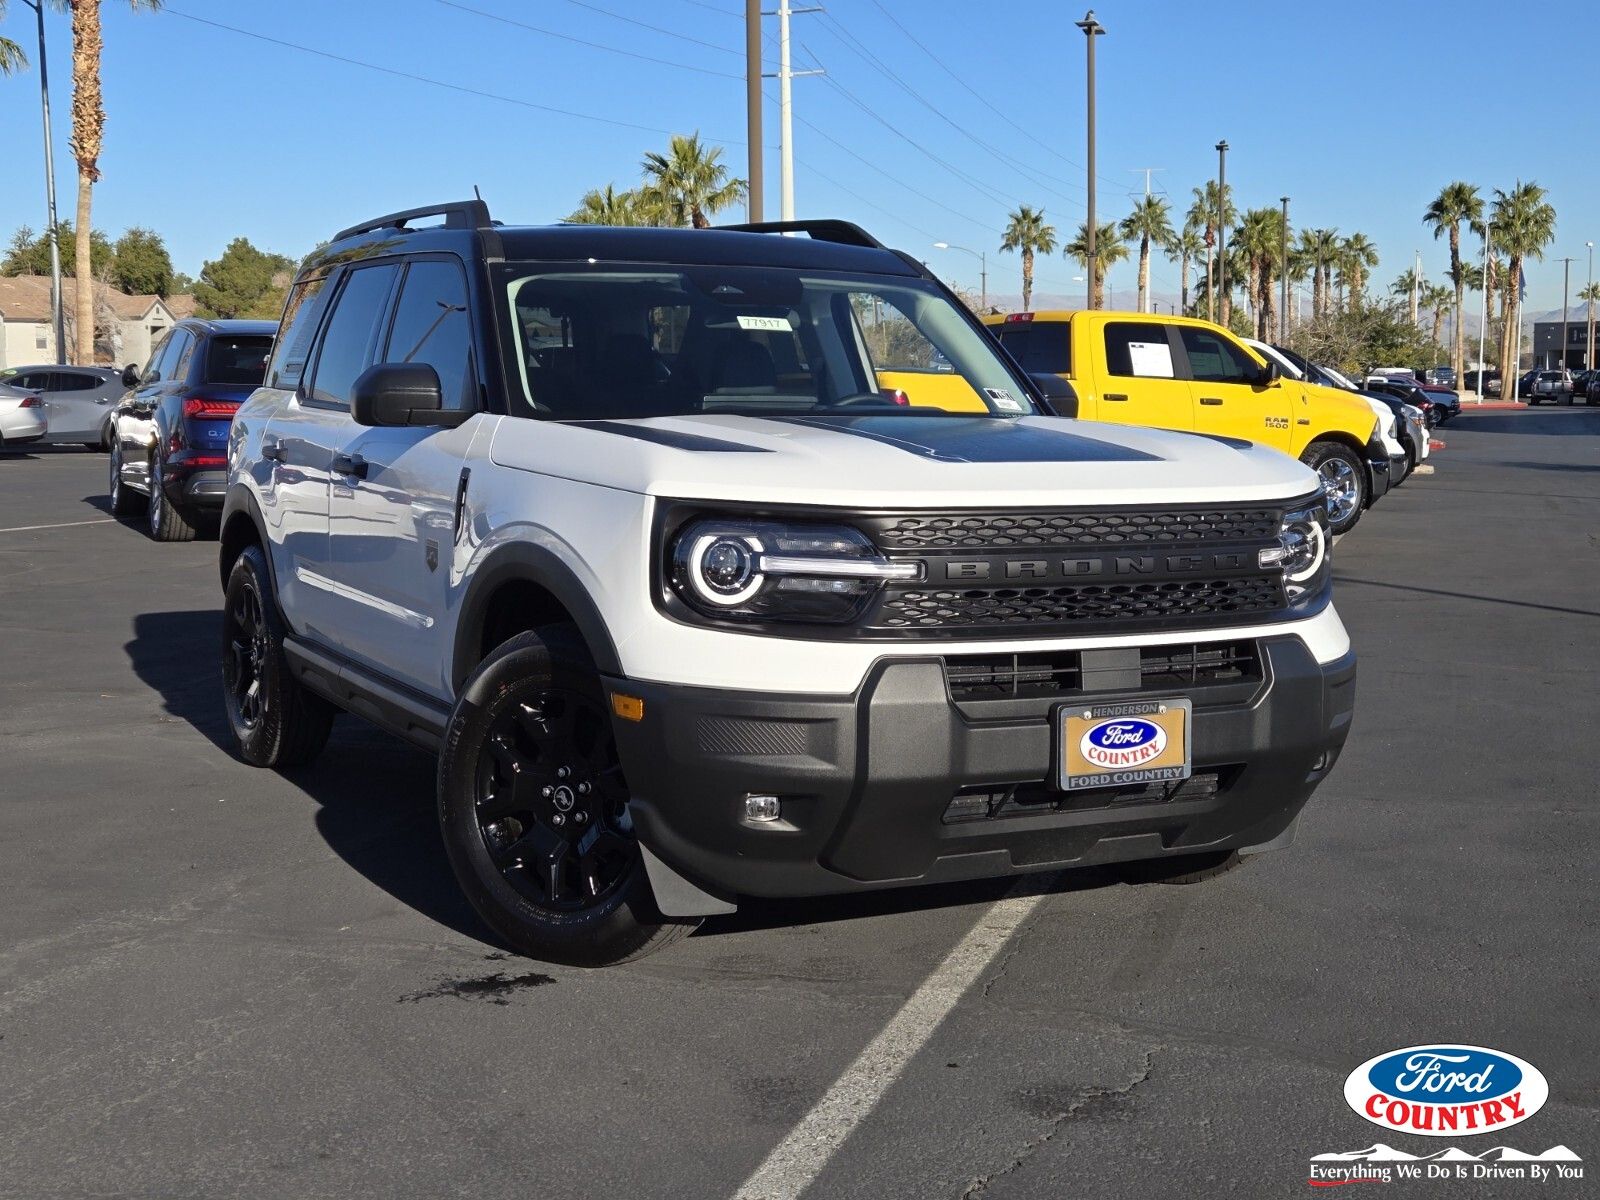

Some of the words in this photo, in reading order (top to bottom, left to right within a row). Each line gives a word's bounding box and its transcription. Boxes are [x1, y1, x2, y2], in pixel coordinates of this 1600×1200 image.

[743, 318, 780, 328] 77917
[1265, 421, 1289, 430] 1500
[945, 552, 1248, 580] BRONCO
[1092, 703, 1159, 717] HENDERSON
[1102, 724, 1144, 745] Ford
[1088, 740, 1160, 765] COUNTRY
[1070, 774, 1111, 788] FORD
[1113, 767, 1183, 784] COUNTRY
